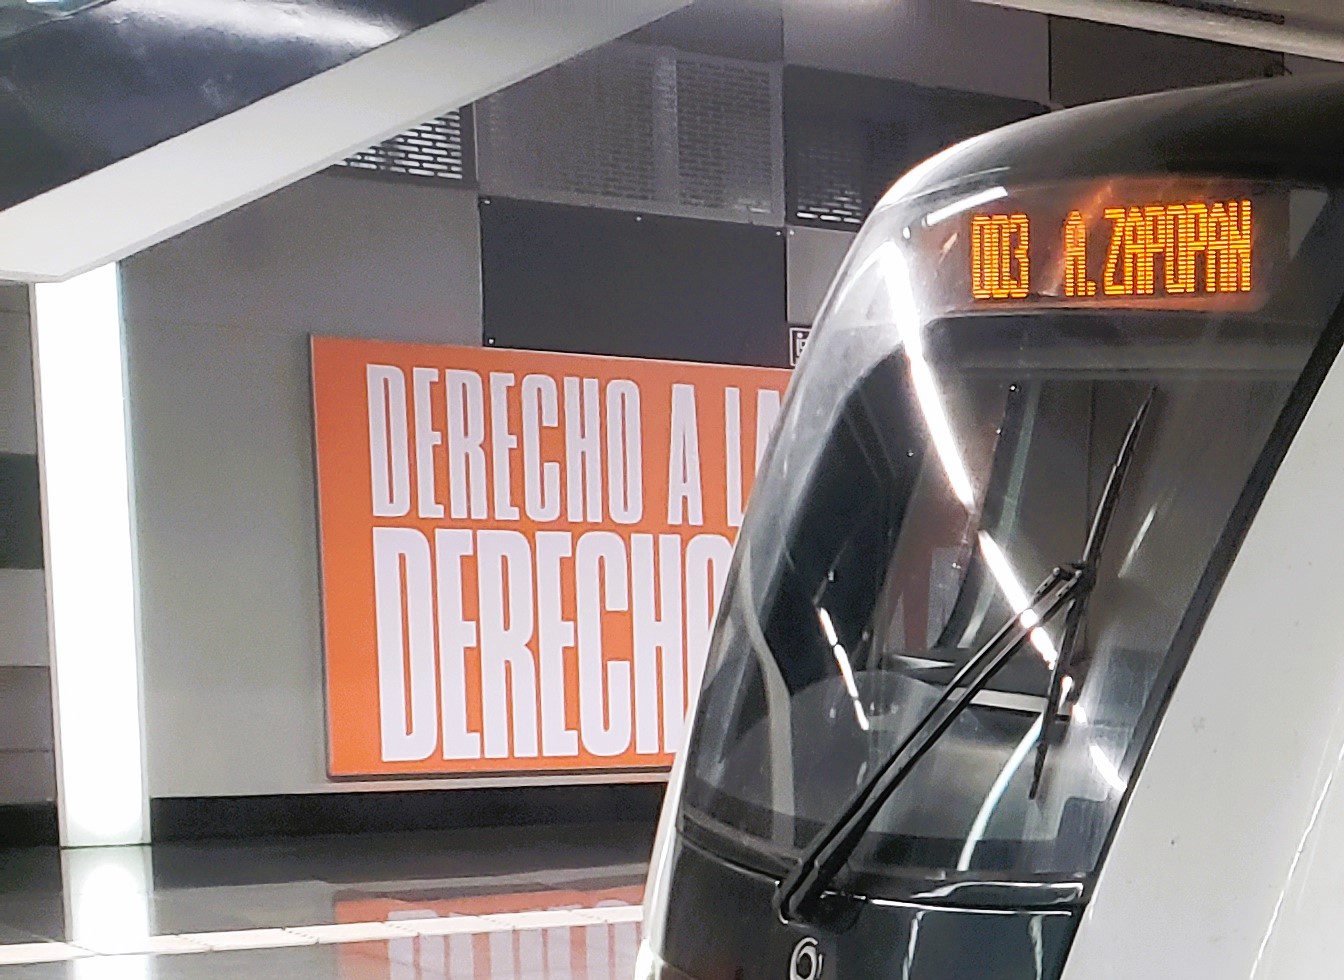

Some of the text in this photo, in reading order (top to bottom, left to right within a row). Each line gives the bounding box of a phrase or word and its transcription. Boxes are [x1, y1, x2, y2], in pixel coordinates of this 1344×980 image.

[972, 214, 1029, 299] 003
[366, 363, 643, 524] DERECHO
[668, 383, 704, 526] A
